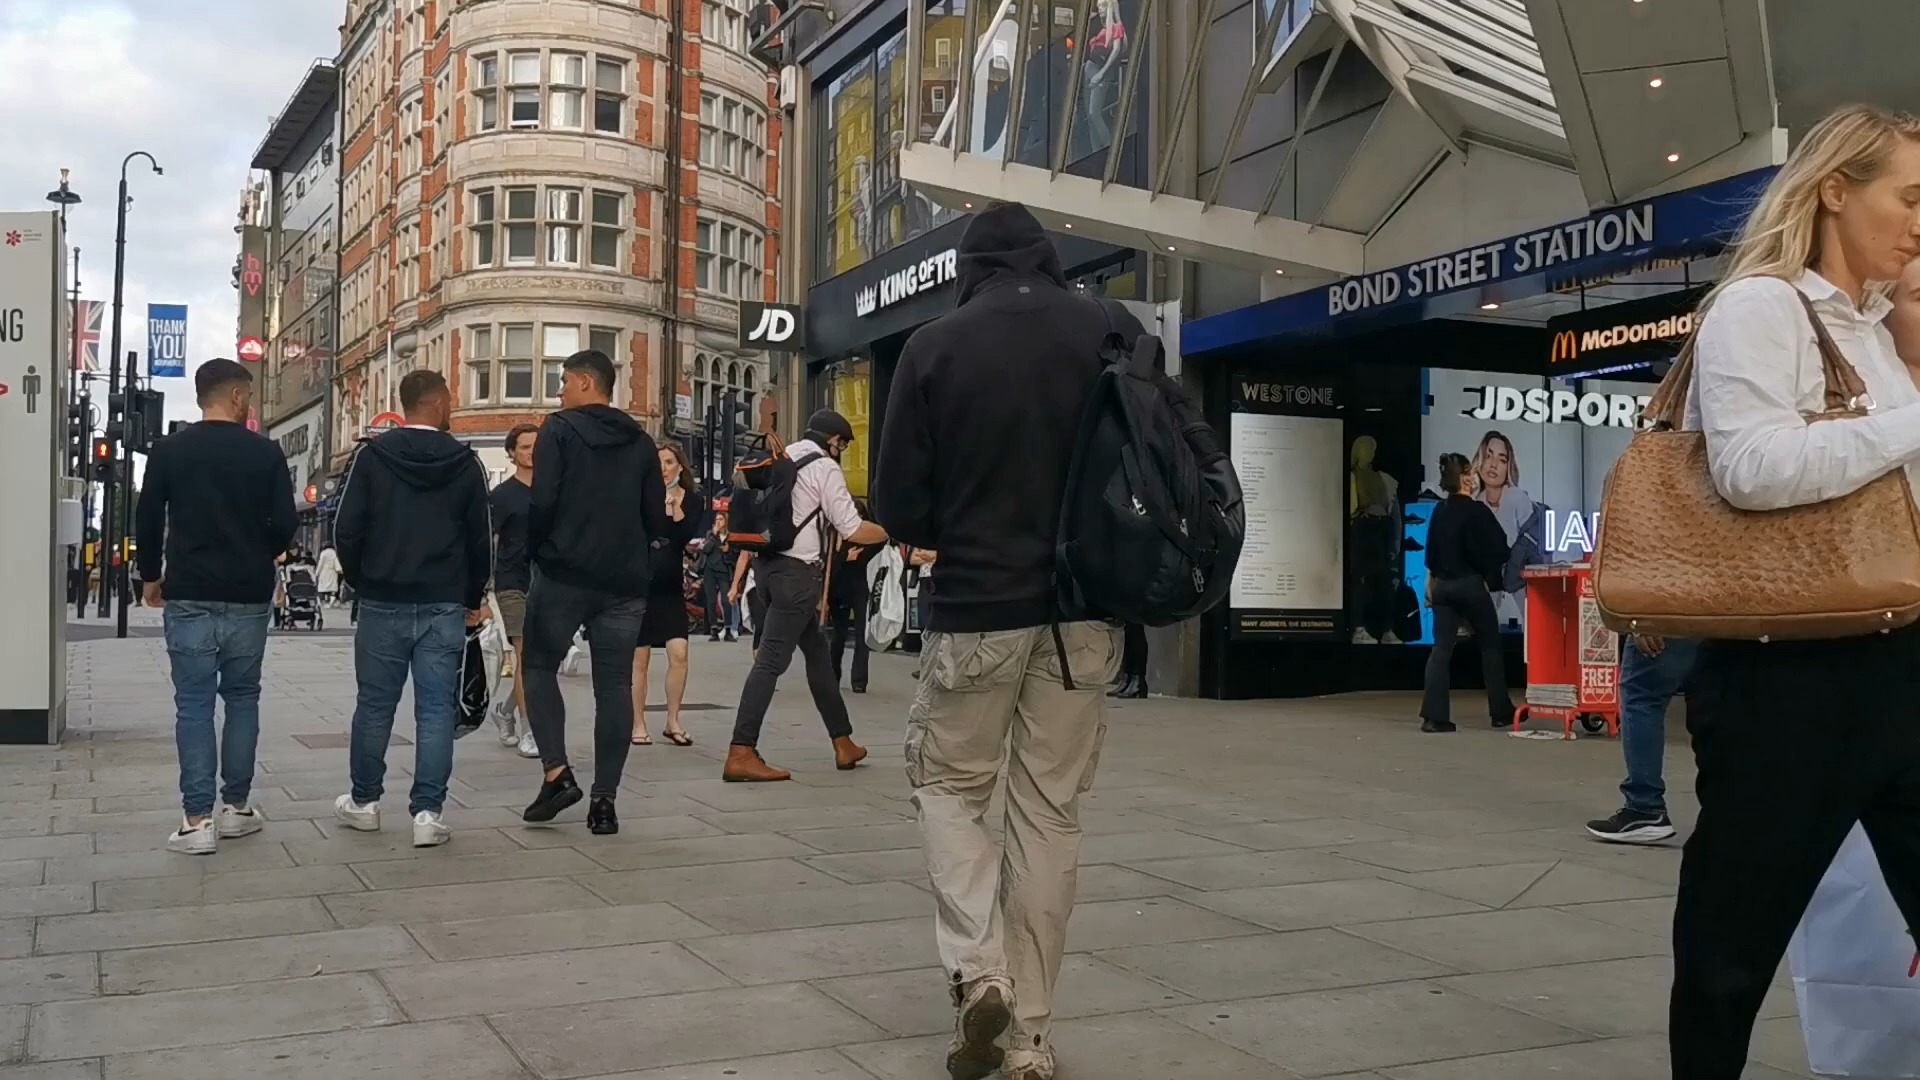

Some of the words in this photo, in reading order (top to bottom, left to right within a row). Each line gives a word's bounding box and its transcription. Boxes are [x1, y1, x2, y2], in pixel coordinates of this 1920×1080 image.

[243, 253, 263, 295] hmv
[1328, 271, 1402, 317] BOND
[1407, 243, 1506, 299] STREET
[1512, 203, 1655, 272] STATION
[879, 264, 918, 308] KING
[918, 255, 936, 282] OF
[149, 318, 186, 335] THANK
[748, 308, 795, 342] JD
[151, 335, 186, 359] YOU
[1582, 667, 1614, 688] FREE
